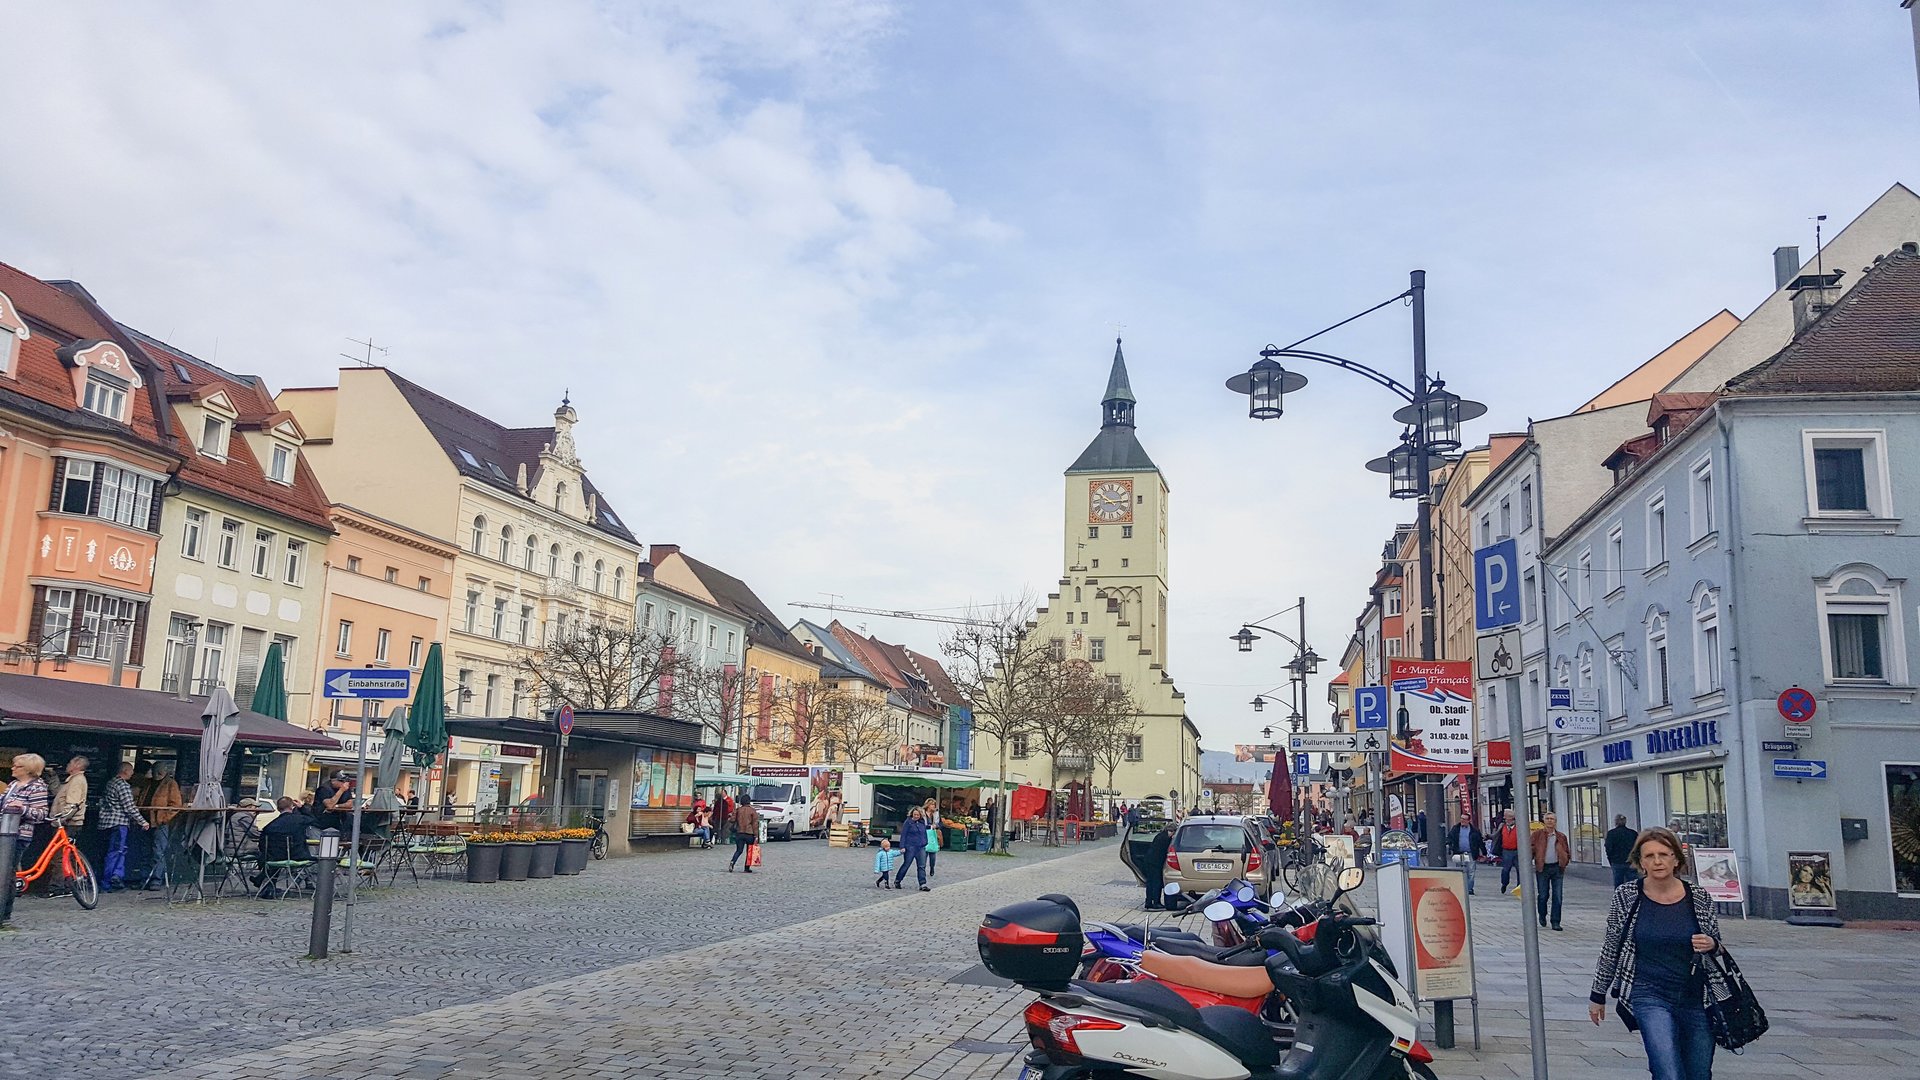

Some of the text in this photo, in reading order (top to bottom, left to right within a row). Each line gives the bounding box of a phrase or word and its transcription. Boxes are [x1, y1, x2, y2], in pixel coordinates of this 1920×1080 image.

[1485, 554, 1508, 618] P
[1396, 664, 1445, 674] Le Marché
[348, 680, 405, 688] Einbahnstraße
[1427, 675, 1469, 685] Français
[1360, 692, 1377, 724] P
[1429, 705, 1469, 714] Ob. Stadt-
[1440, 717, 1460, 726] platz
[1429, 732, 1470, 740] 31.03.-02.04.
[1299, 756, 1307, 772] P
